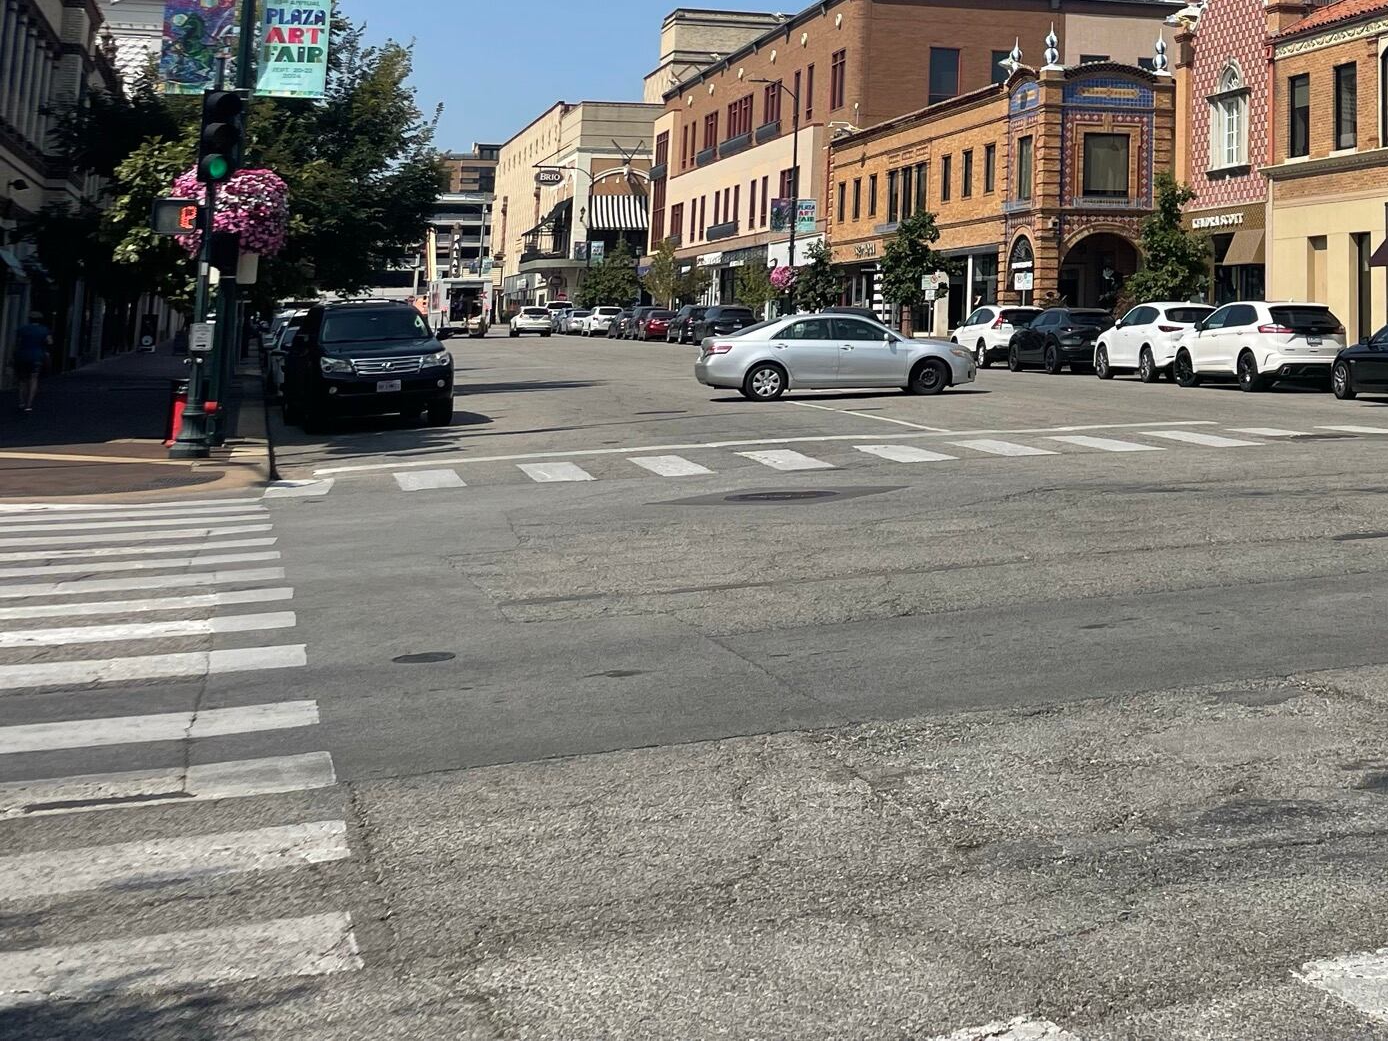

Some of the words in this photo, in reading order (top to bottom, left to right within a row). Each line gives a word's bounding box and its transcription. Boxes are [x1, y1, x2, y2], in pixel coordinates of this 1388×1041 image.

[266, 8, 326, 25] PLAZA
[264, 26, 325, 44] ART
[264, 45, 324, 63] FAIR
[540, 172, 560, 180] BRIO
[452, 234, 460, 277] PALAC
